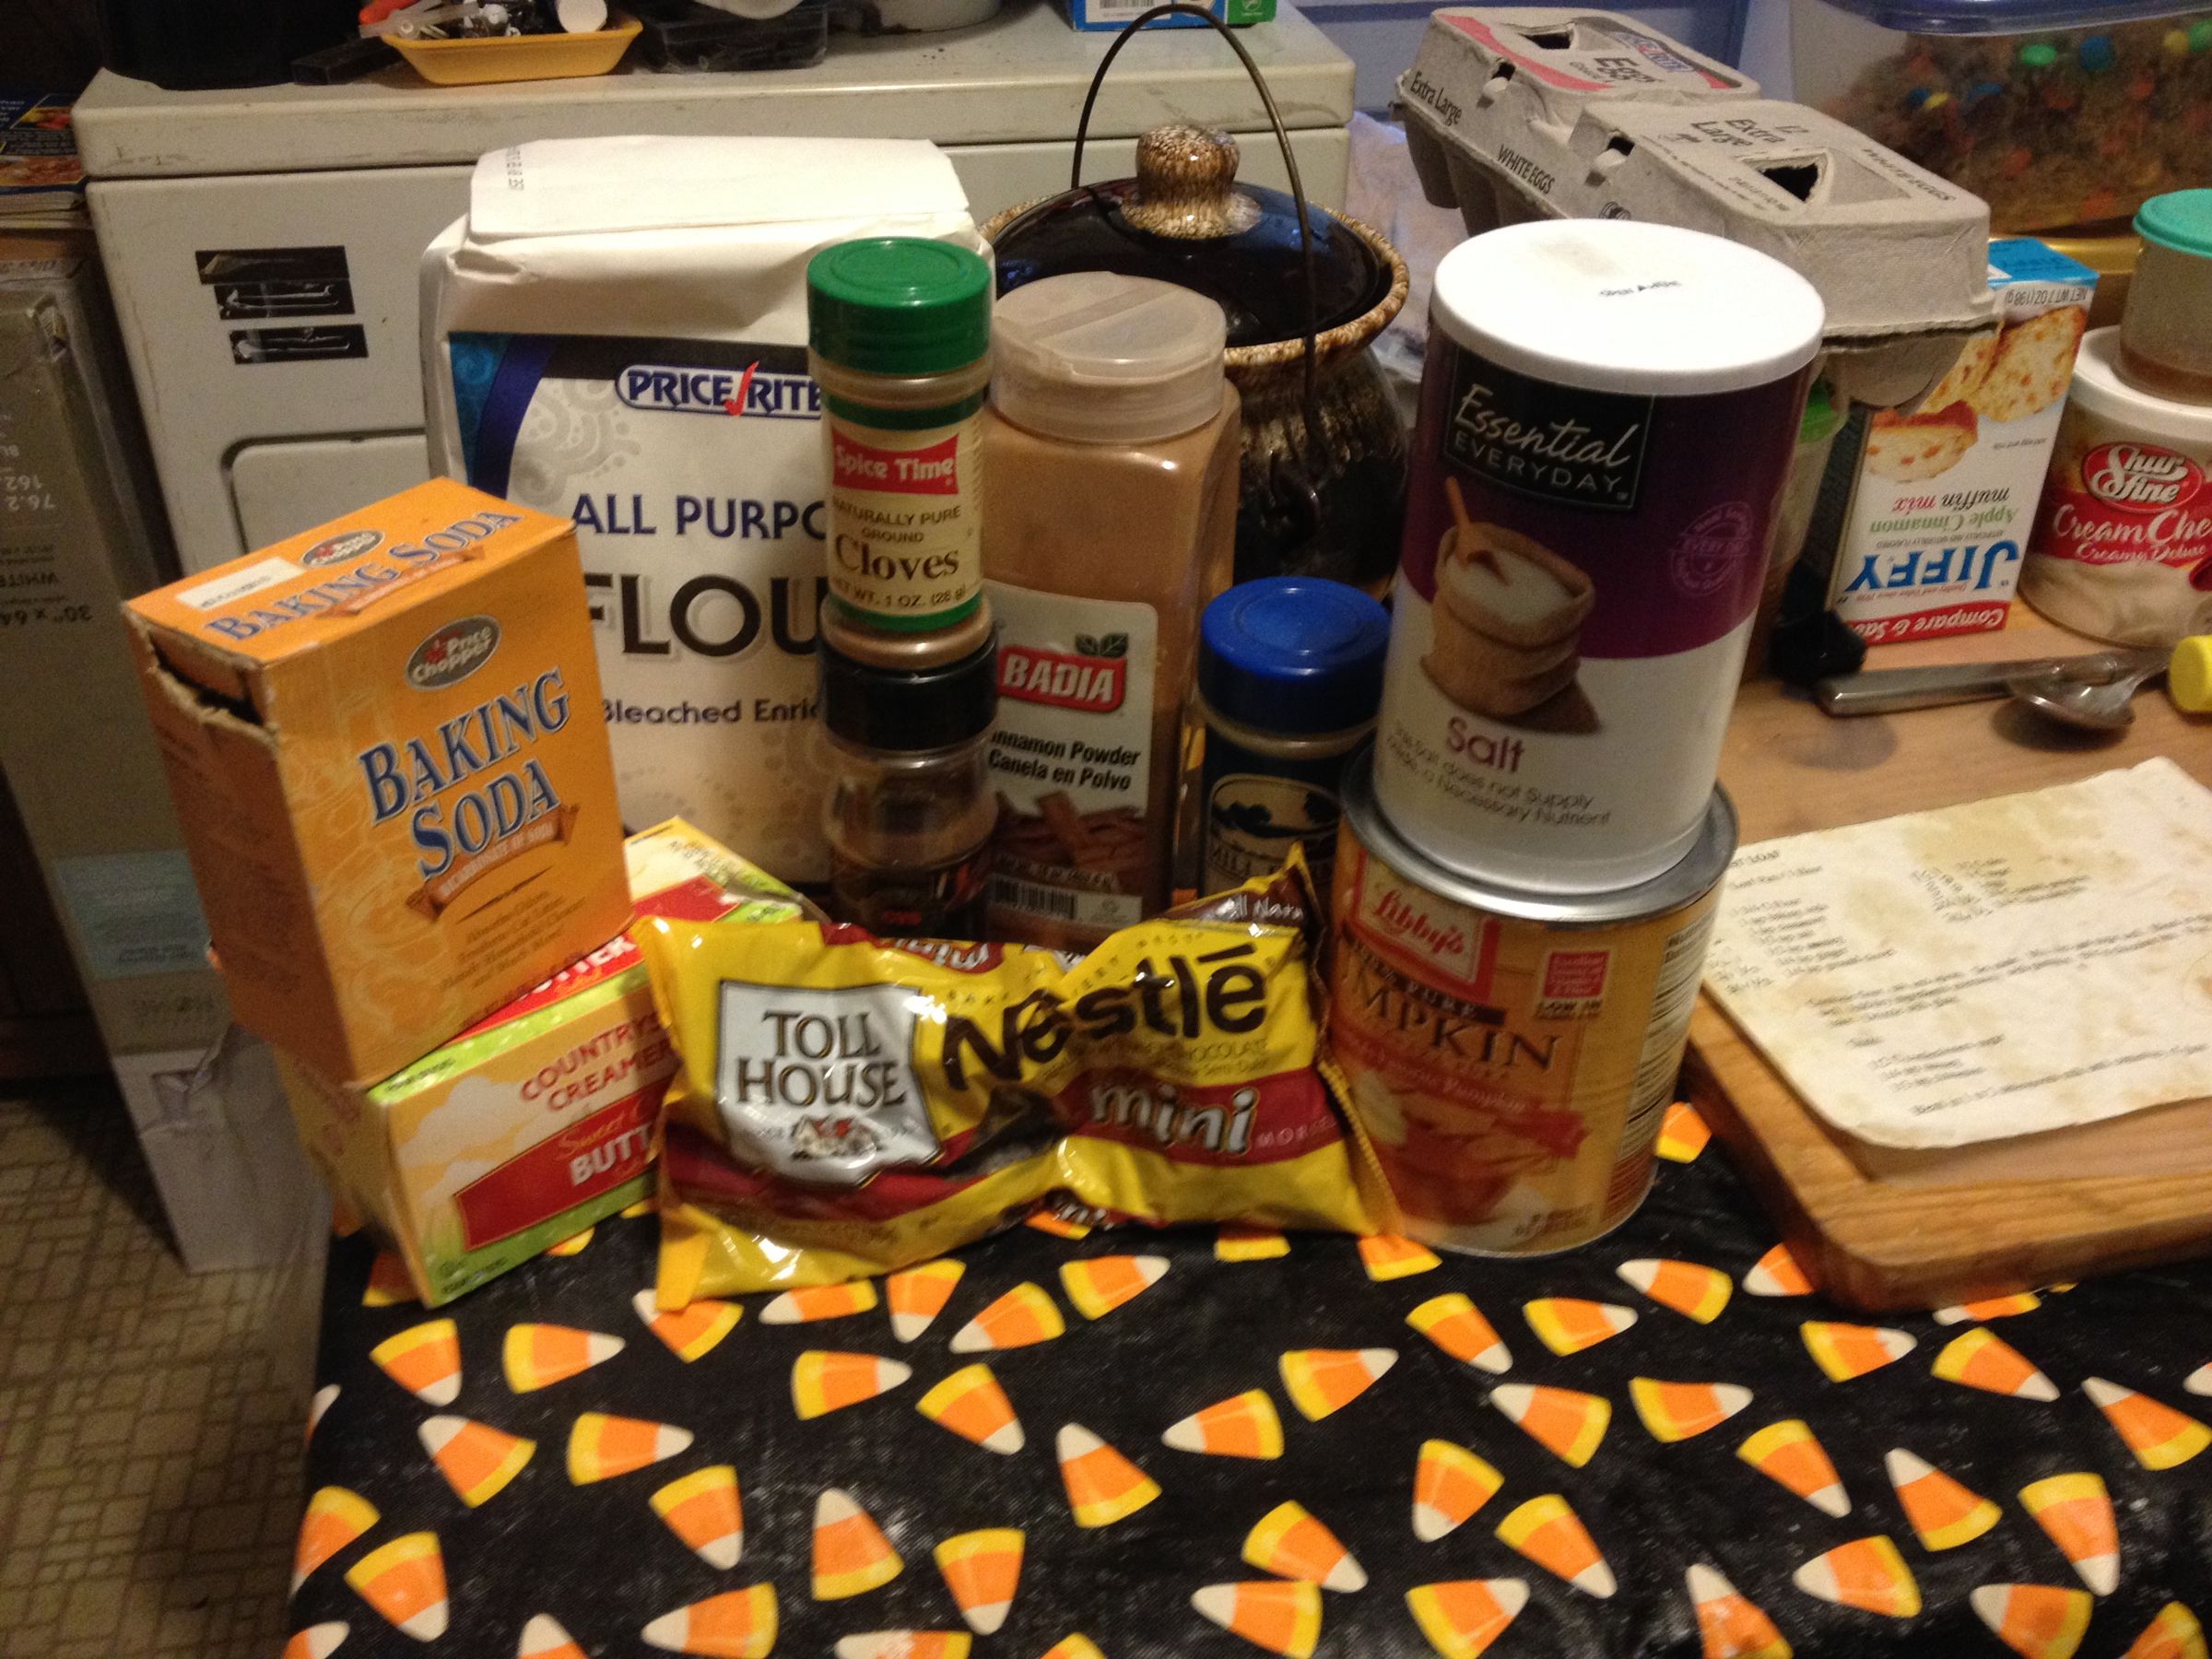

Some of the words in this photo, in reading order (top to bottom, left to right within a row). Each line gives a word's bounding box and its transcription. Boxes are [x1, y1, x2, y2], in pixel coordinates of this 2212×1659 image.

[1410, 71, 1434, 104] Extra
[1435, 95, 1463, 128] Large
[1690, 121, 1753, 147] Large
[1724, 118, 1786, 143] Extra
[1498, 144, 1530, 179] WHITE
[1529, 166, 1557, 196] EGGS
[627, 369, 734, 408] PRICE
[1453, 382, 1641, 470] Essential
[835, 443, 888, 480] Spice
[893, 455, 955, 482] Time
[1453, 431, 1623, 493] EVERYDAY
[571, 493, 657, 535] ALL
[832, 495, 915, 527] NATURALLY
[921, 504, 961, 526] PURE
[1891, 495, 1937, 514] mix
[1940, 487, 2010, 512] muffin
[1968, 506, 2020, 533] Apple
[862, 526, 925, 544] GROUND
[1870, 514, 1965, 534] Cinnamon
[2052, 502, 2147, 547] Cream
[835, 532, 959, 582] Cloves
[2077, 541, 2148, 568] Creamy
[205, 562, 402, 643] BAKING
[387, 512, 526, 565] SODA
[447, 625, 493, 657] Price
[1891, 618, 1910, 636] &
[1913, 606, 2005, 632] Compare
[410, 636, 493, 683] Chopper
[1002, 653, 1116, 704] BADIA
[358, 665, 571, 828] BAKING
[1069, 738, 1142, 767] Powder
[1445, 715, 1525, 775] Salt
[988, 748, 1049, 781] Canela
[1052, 763, 1076, 784] en
[1078, 764, 1133, 793] Polvo
[1442, 760, 1486, 789] does
[1488, 782, 1522, 799] not
[1525, 785, 1596, 811] Supply
[411, 756, 561, 881] SODA
[1374, 888, 1465, 957] Libby's
[760, 1009, 883, 1060] TOLL
[737, 1057, 908, 1108] HOUSE
[1089, 1083, 1263, 1155] mini
